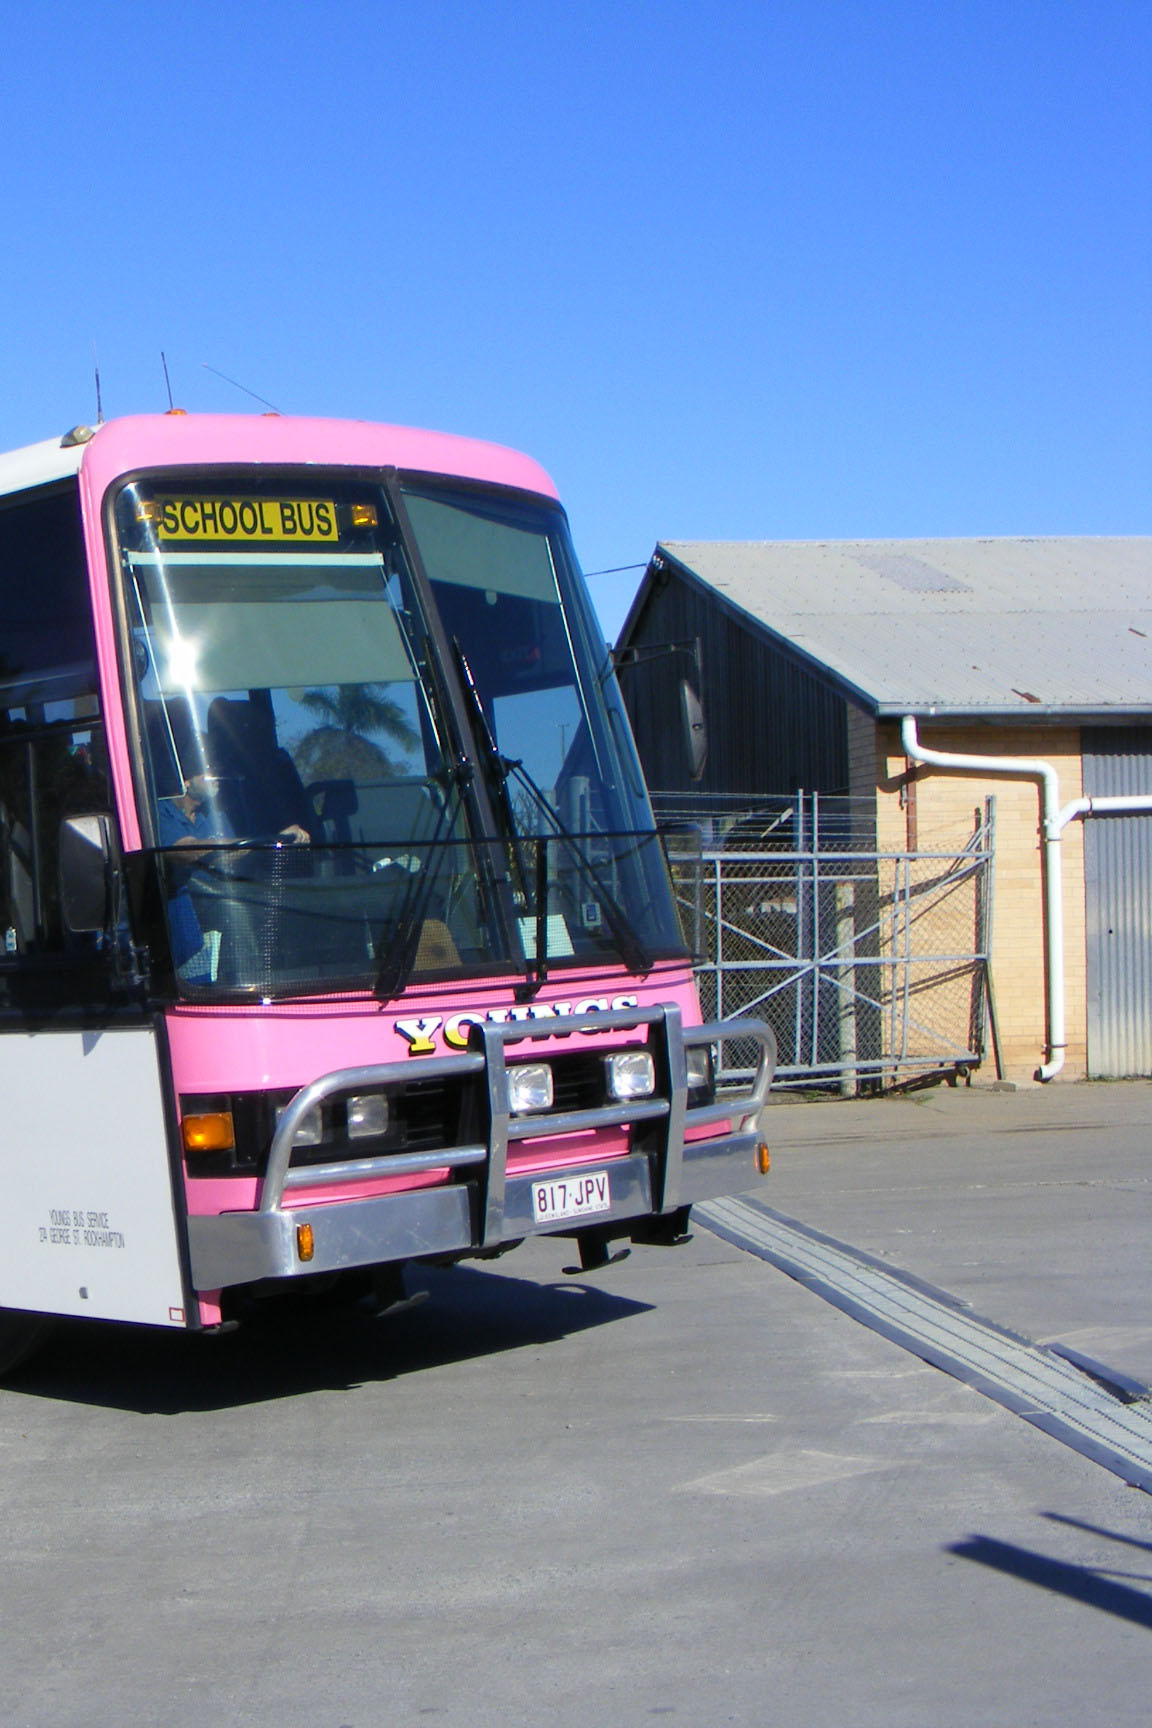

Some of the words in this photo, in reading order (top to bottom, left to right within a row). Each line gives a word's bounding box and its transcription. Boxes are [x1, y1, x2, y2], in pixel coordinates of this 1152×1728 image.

[161, 500, 273, 535] SCHOOL
[280, 502, 333, 536] BUS
[49, 1209, 71, 1226] YOUNGS
[73, 1211, 84, 1227] BUS
[87, 1212, 109, 1229] SERVICE
[49, 1227, 72, 1245] GEORGE
